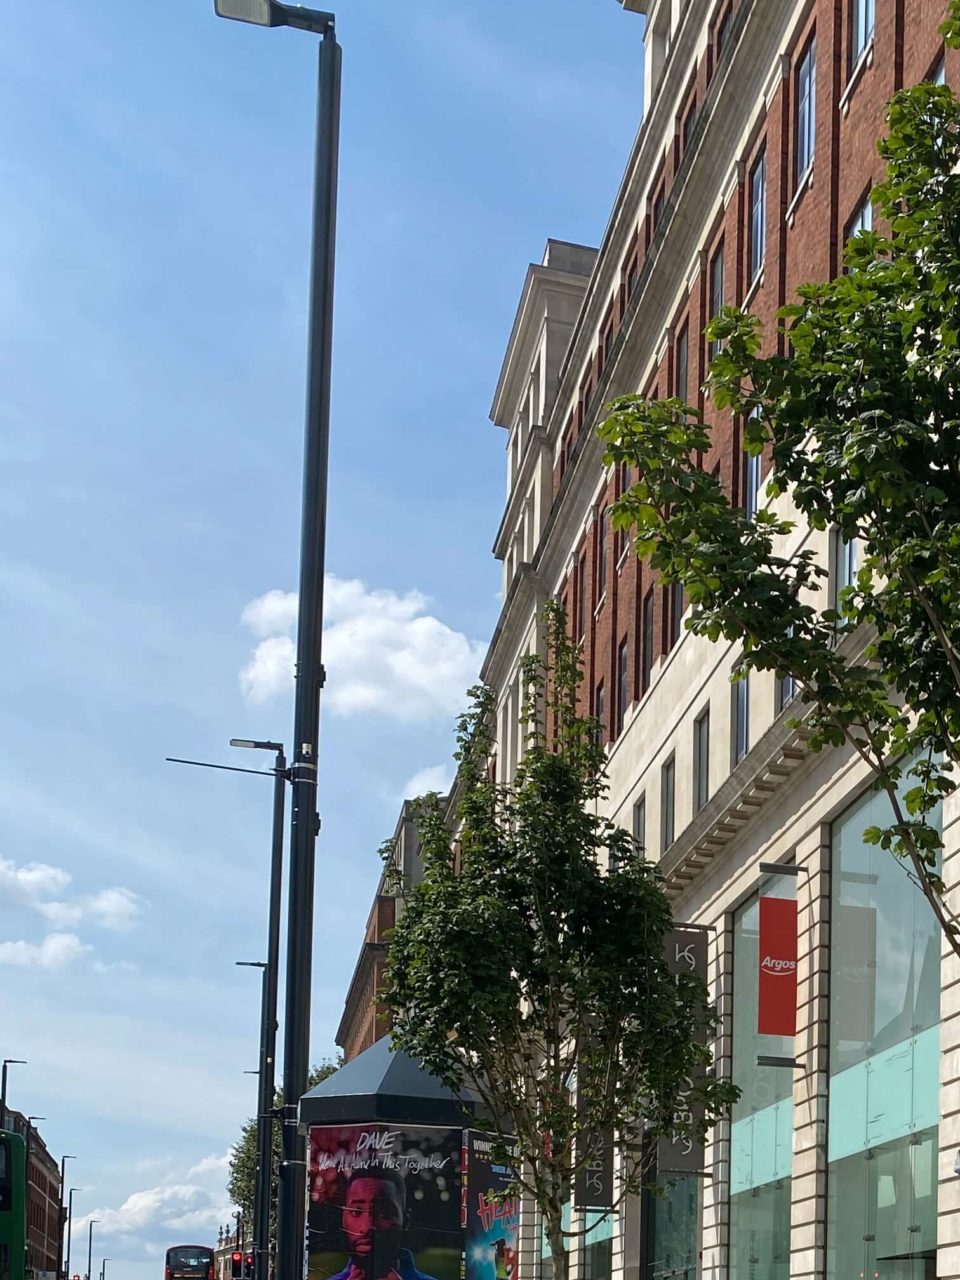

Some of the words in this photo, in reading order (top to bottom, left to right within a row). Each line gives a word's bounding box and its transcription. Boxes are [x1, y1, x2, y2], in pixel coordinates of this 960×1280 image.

[761, 956, 796, 971] Argos
[357, 1131, 402, 1151] DAVE
[473, 1139, 496, 1154] WINNE
[377, 1150, 401, 1171] This
[399, 1153, 451, 1174] Together
